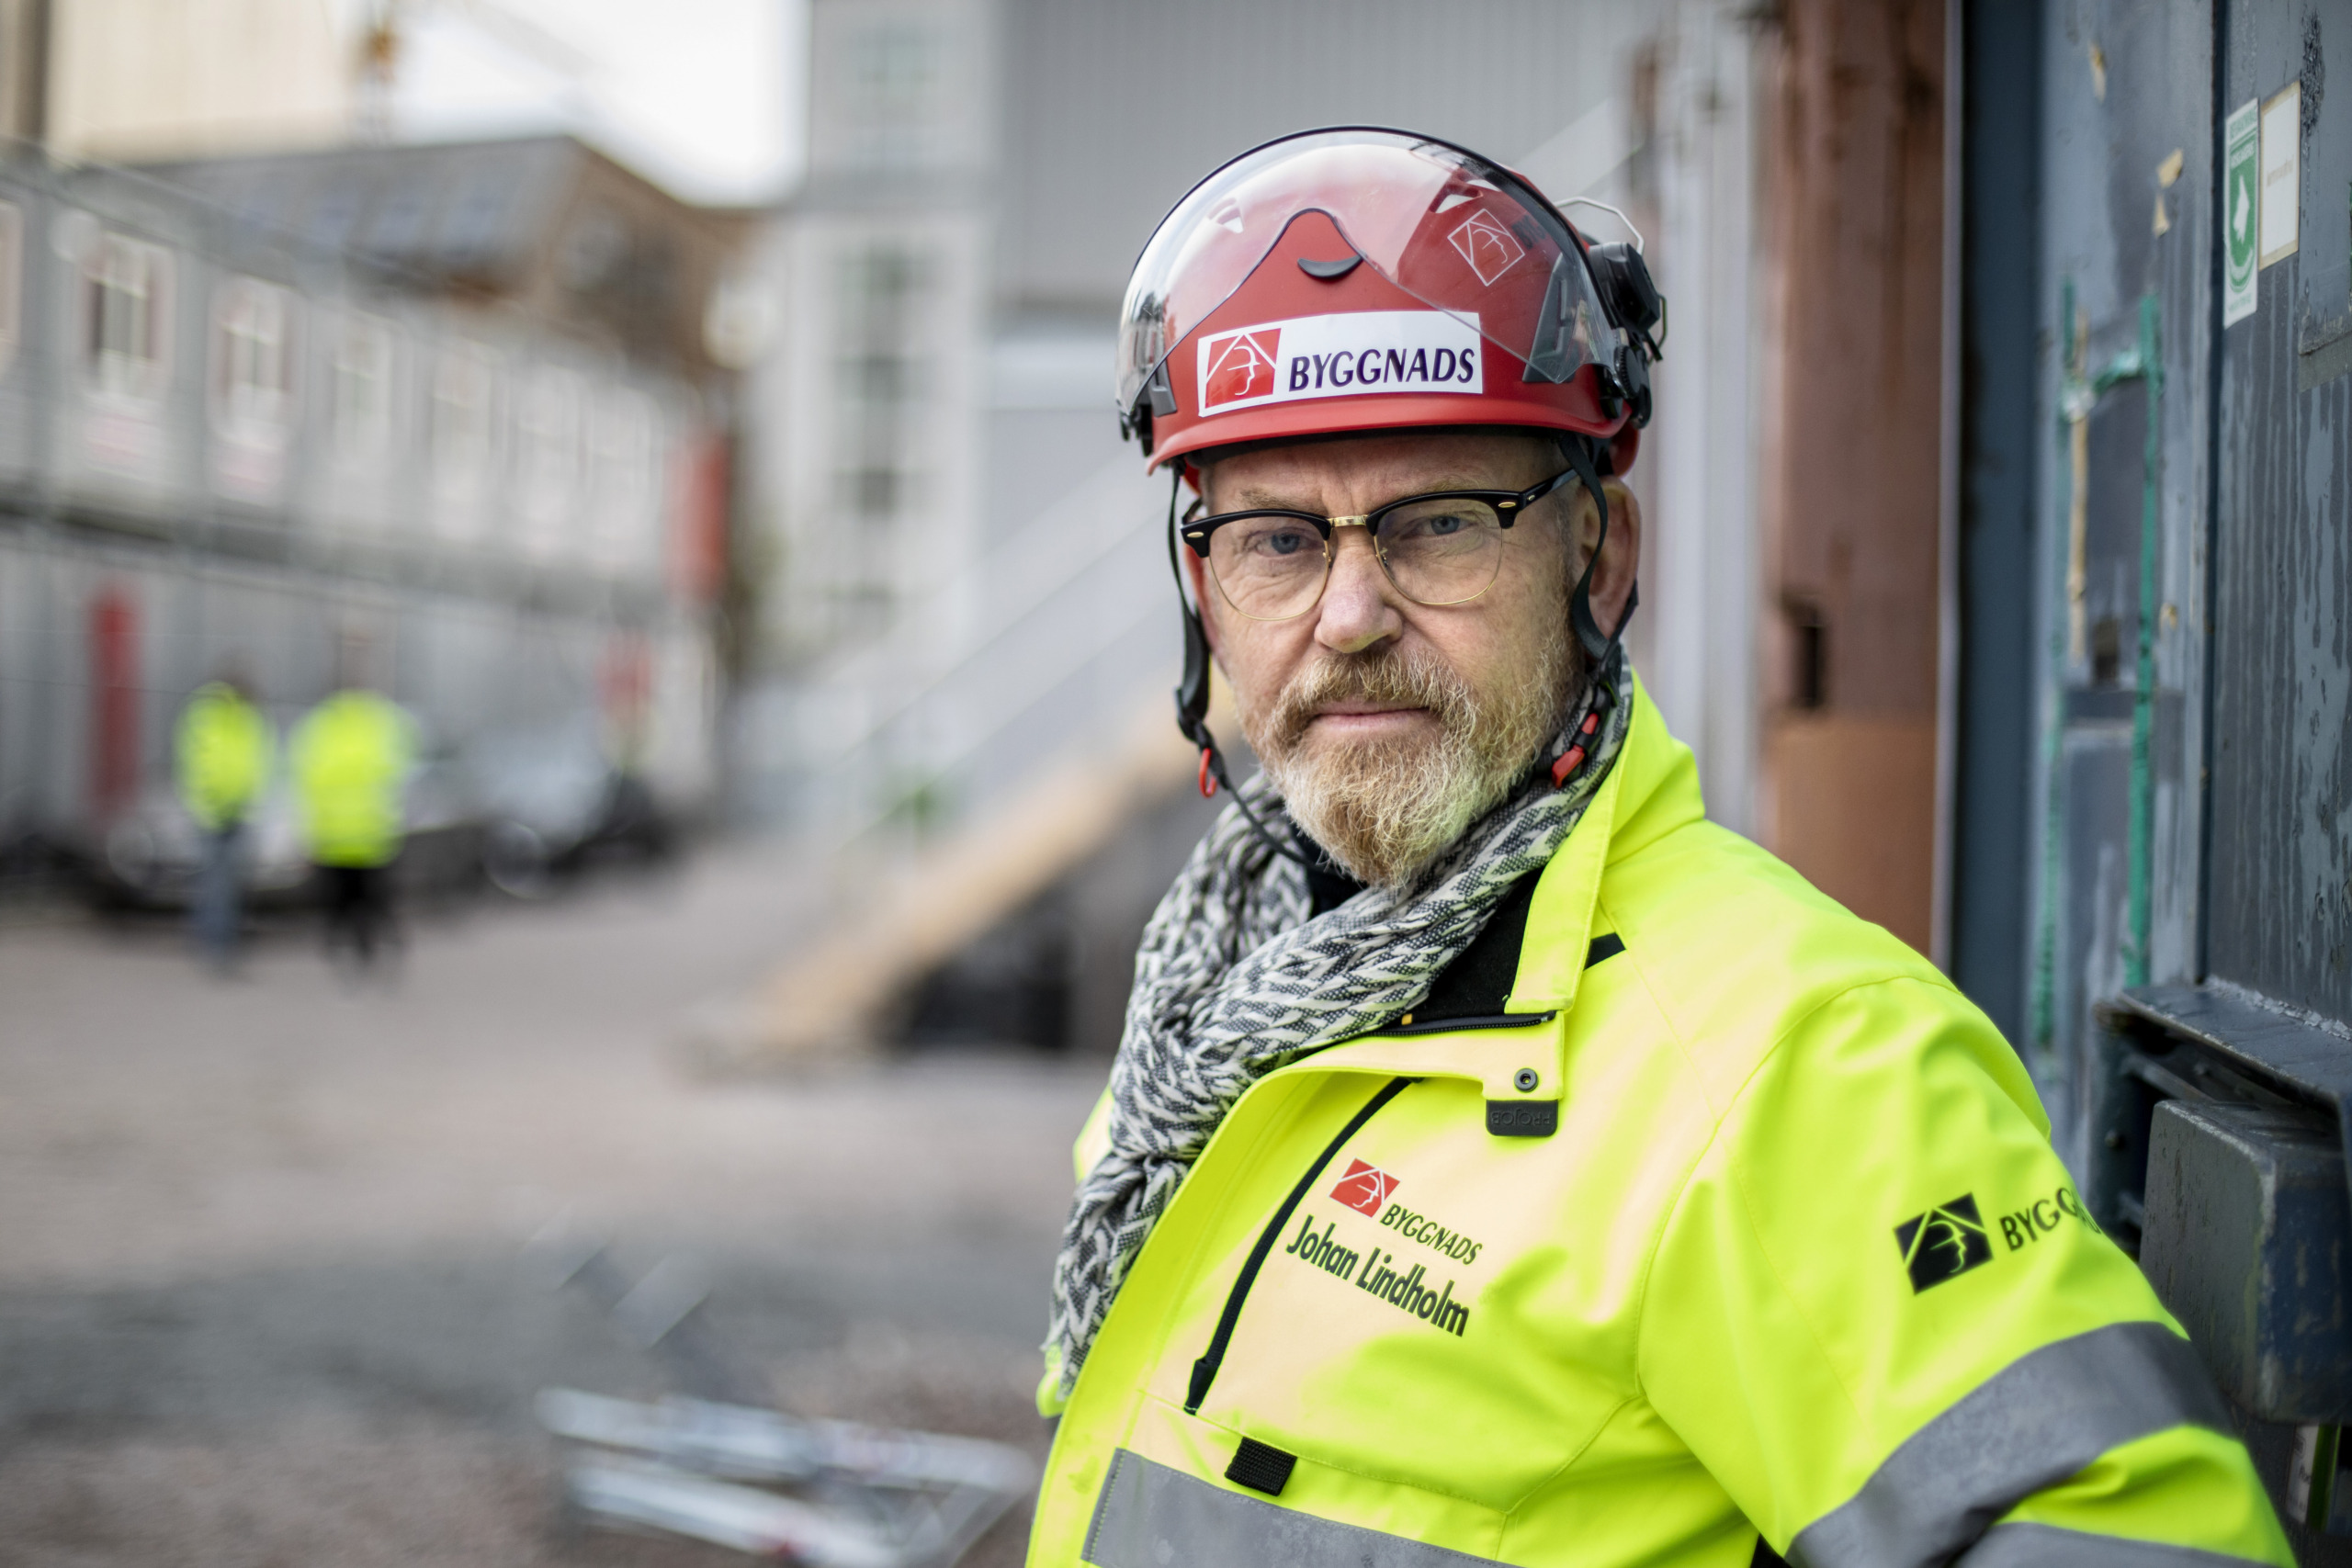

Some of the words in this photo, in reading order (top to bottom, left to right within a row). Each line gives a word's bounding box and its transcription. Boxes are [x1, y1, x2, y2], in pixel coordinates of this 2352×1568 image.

[1289, 347, 1476, 392] BYGGNADS
[1380, 1203, 1483, 1266] BYGGNADS
[1998, 1186, 2101, 1252] BYGG
[1285, 1213, 1360, 1281] Johan
[1354, 1246, 1470, 1338] Lindholm
